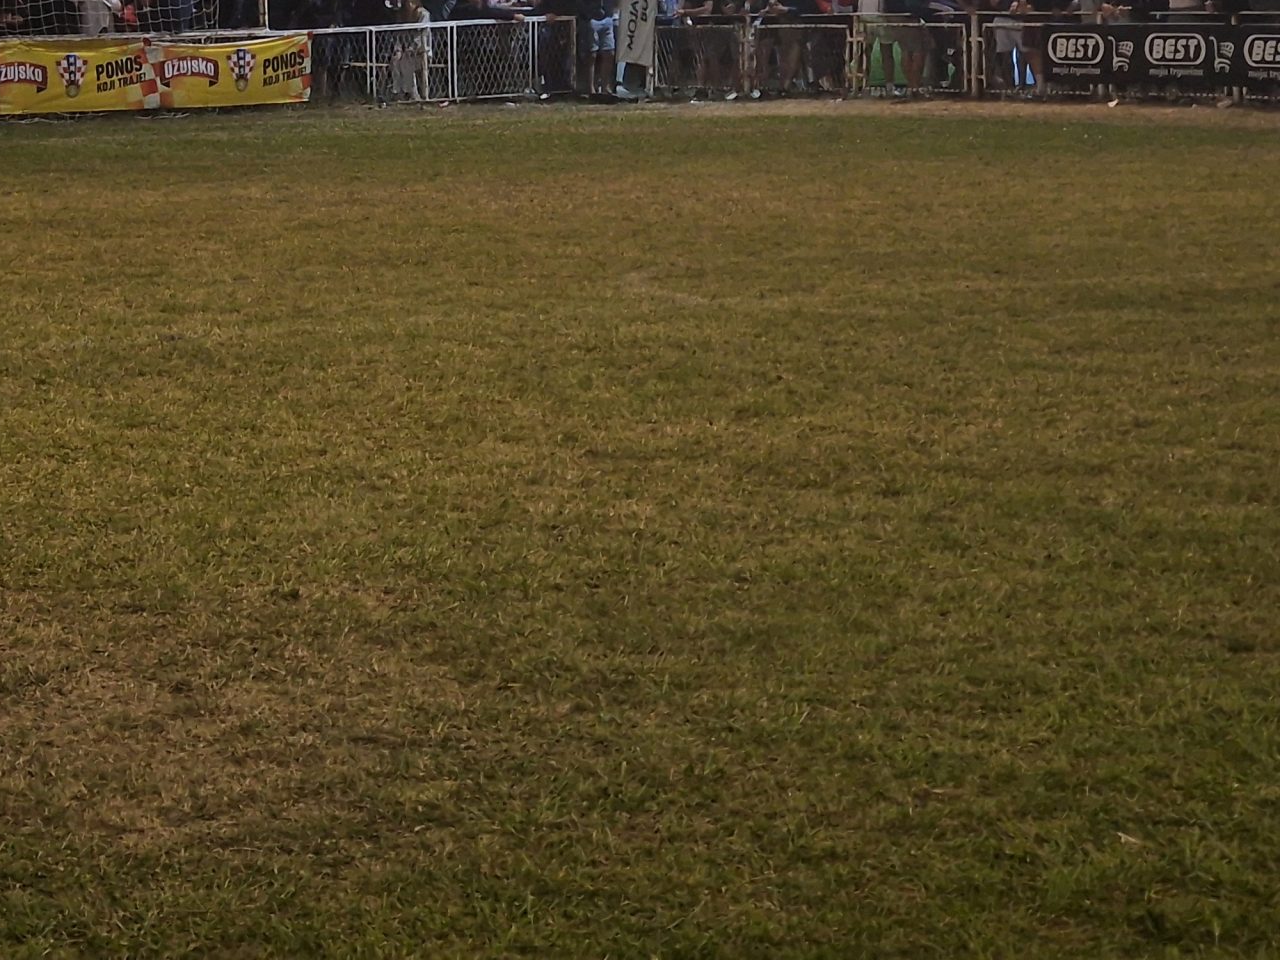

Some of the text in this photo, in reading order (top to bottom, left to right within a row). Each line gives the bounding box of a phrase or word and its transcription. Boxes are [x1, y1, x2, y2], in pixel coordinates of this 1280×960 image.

[626, 0, 639, 51] MOJA
[1056, 38, 1096, 59] BEST
[1152, 38, 1199, 60] BEST
[1252, 40, 1280, 61] BES
[95, 55, 143, 81] PONOS
[164, 58, 215, 79] Ožujsko
[262, 49, 305, 75] PONOS
[96, 73, 146, 93] KOJI TRAJE!
[263, 75, 280, 87] KOJI
